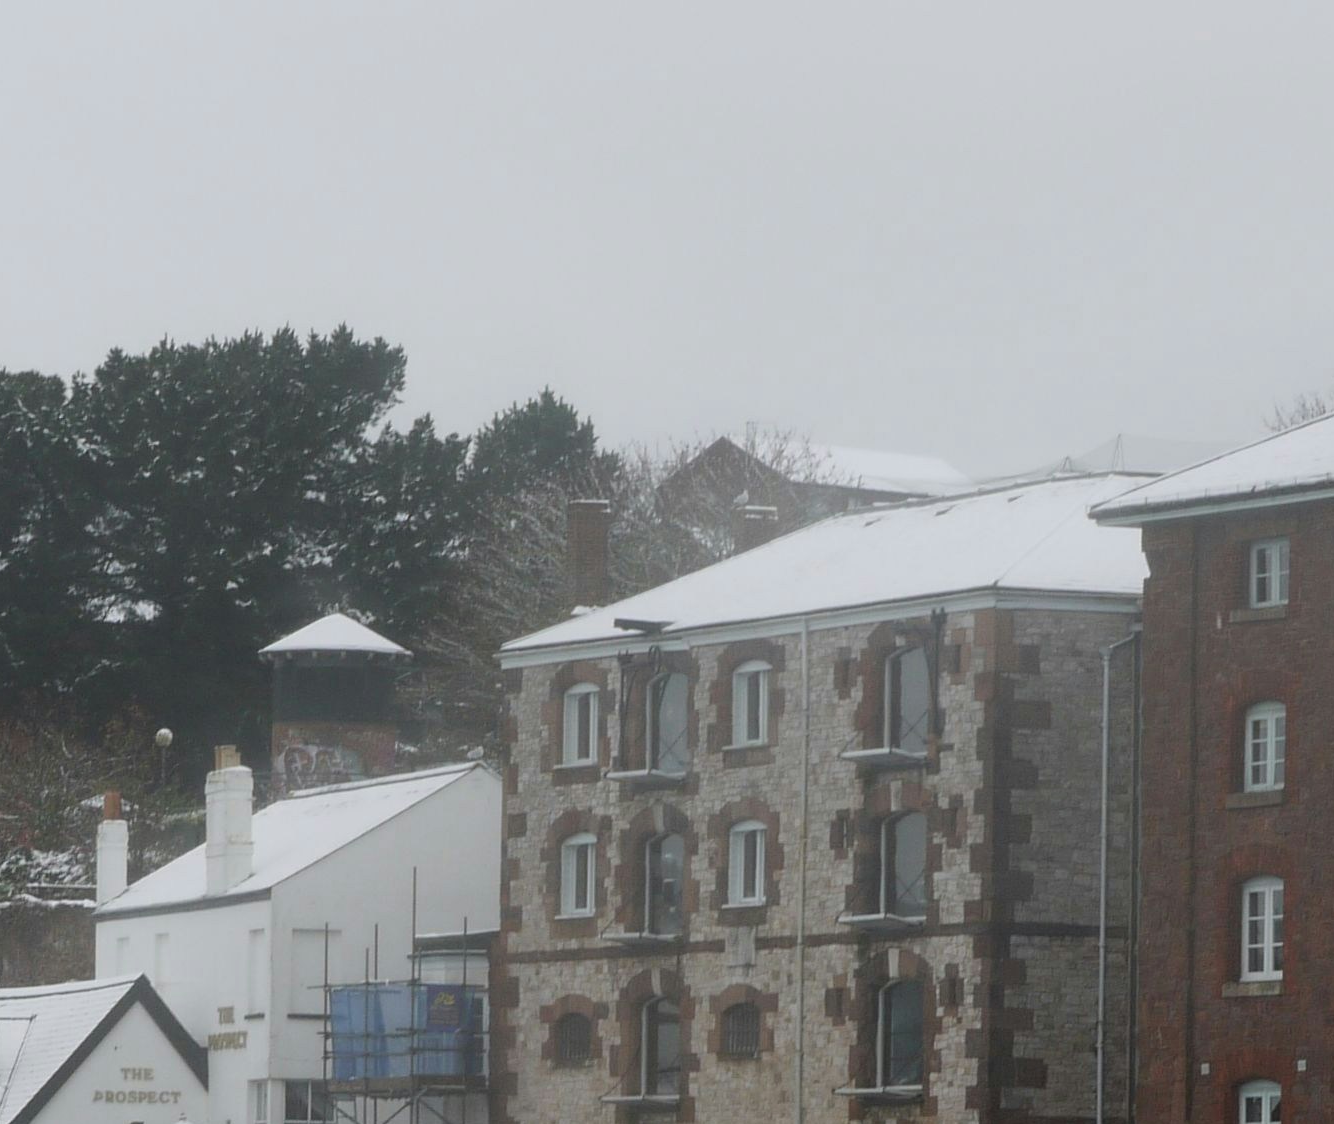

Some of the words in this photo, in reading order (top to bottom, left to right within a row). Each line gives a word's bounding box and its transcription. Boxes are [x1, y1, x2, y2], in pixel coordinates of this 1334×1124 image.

[217, 1006, 235, 1025] THE
[120, 1067, 155, 1081] THE
[92, 1090, 182, 1104] PROSPECT
